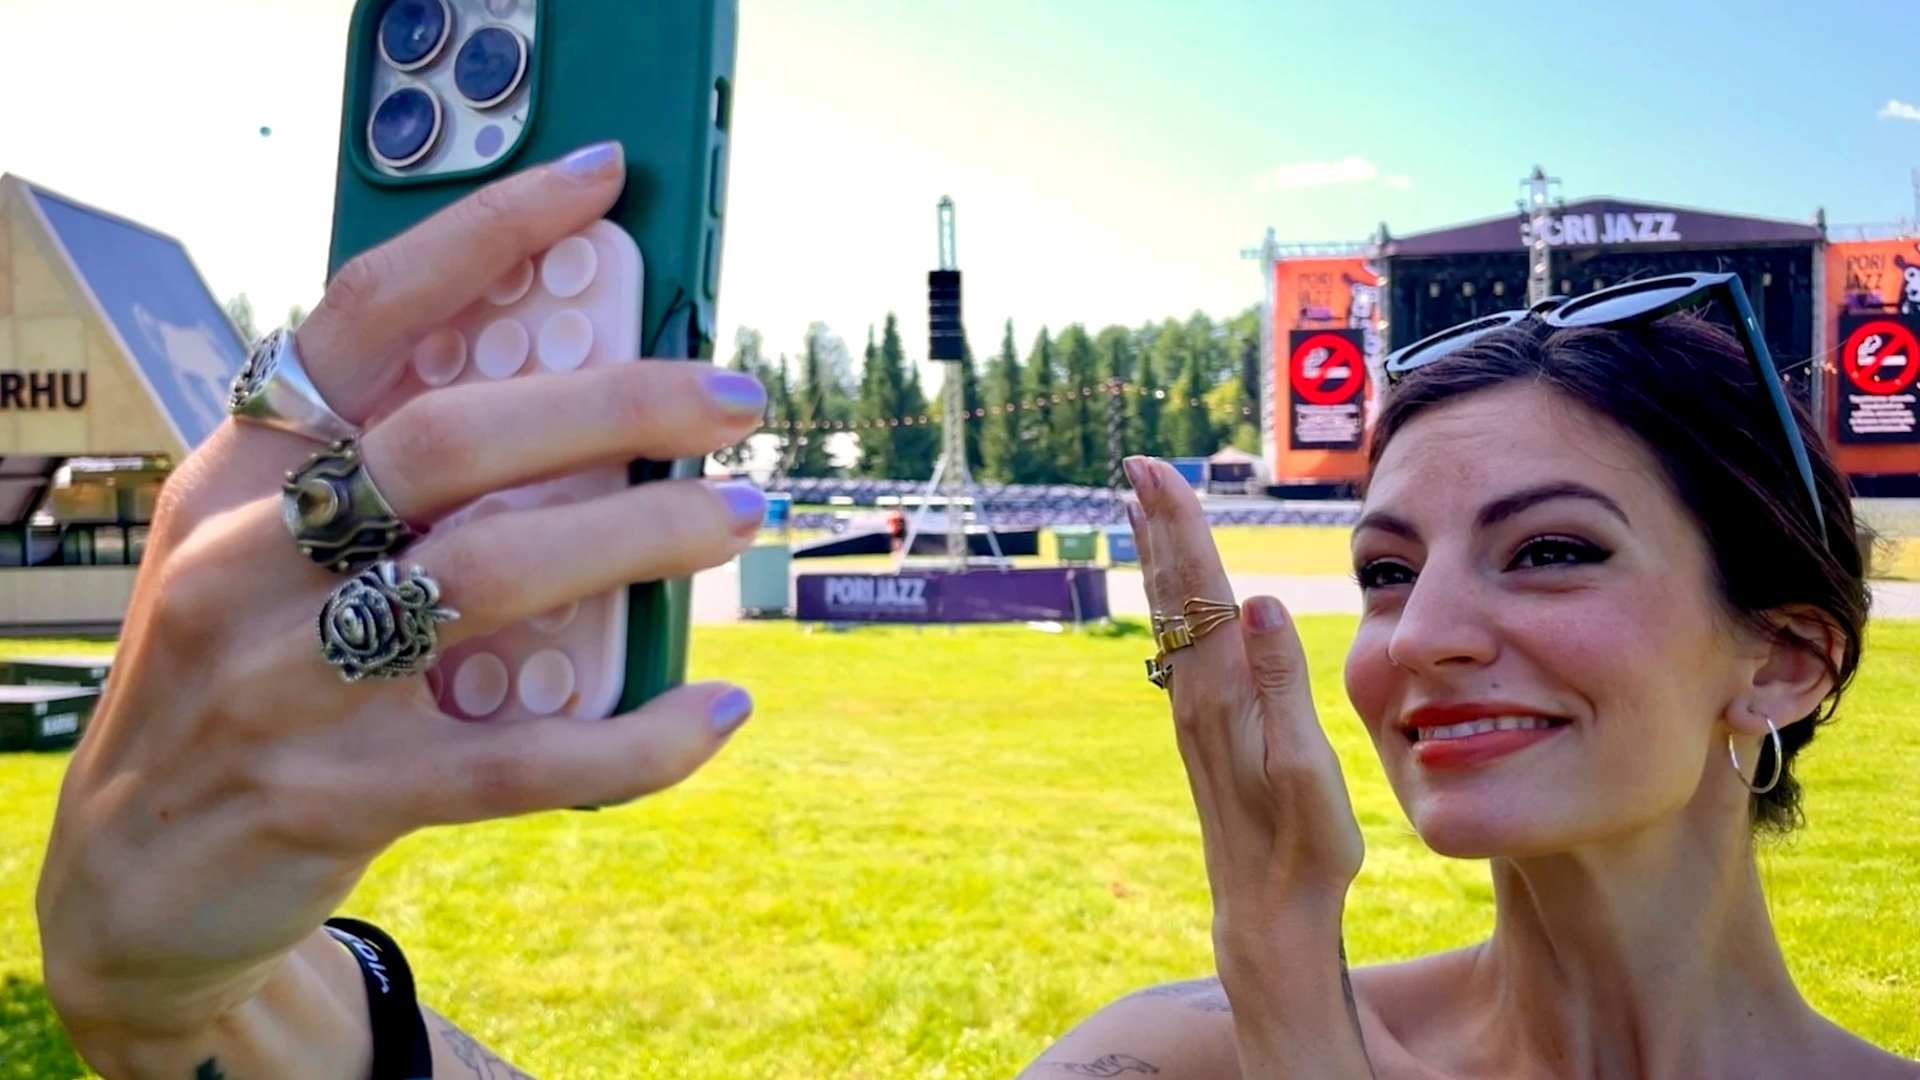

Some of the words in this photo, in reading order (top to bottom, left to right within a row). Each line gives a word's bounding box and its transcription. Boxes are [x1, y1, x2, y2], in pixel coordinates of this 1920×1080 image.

[1600, 212, 1682, 243] JAZZ
[825, 577, 874, 605] PORI
[876, 577, 927, 606] JAZZ
